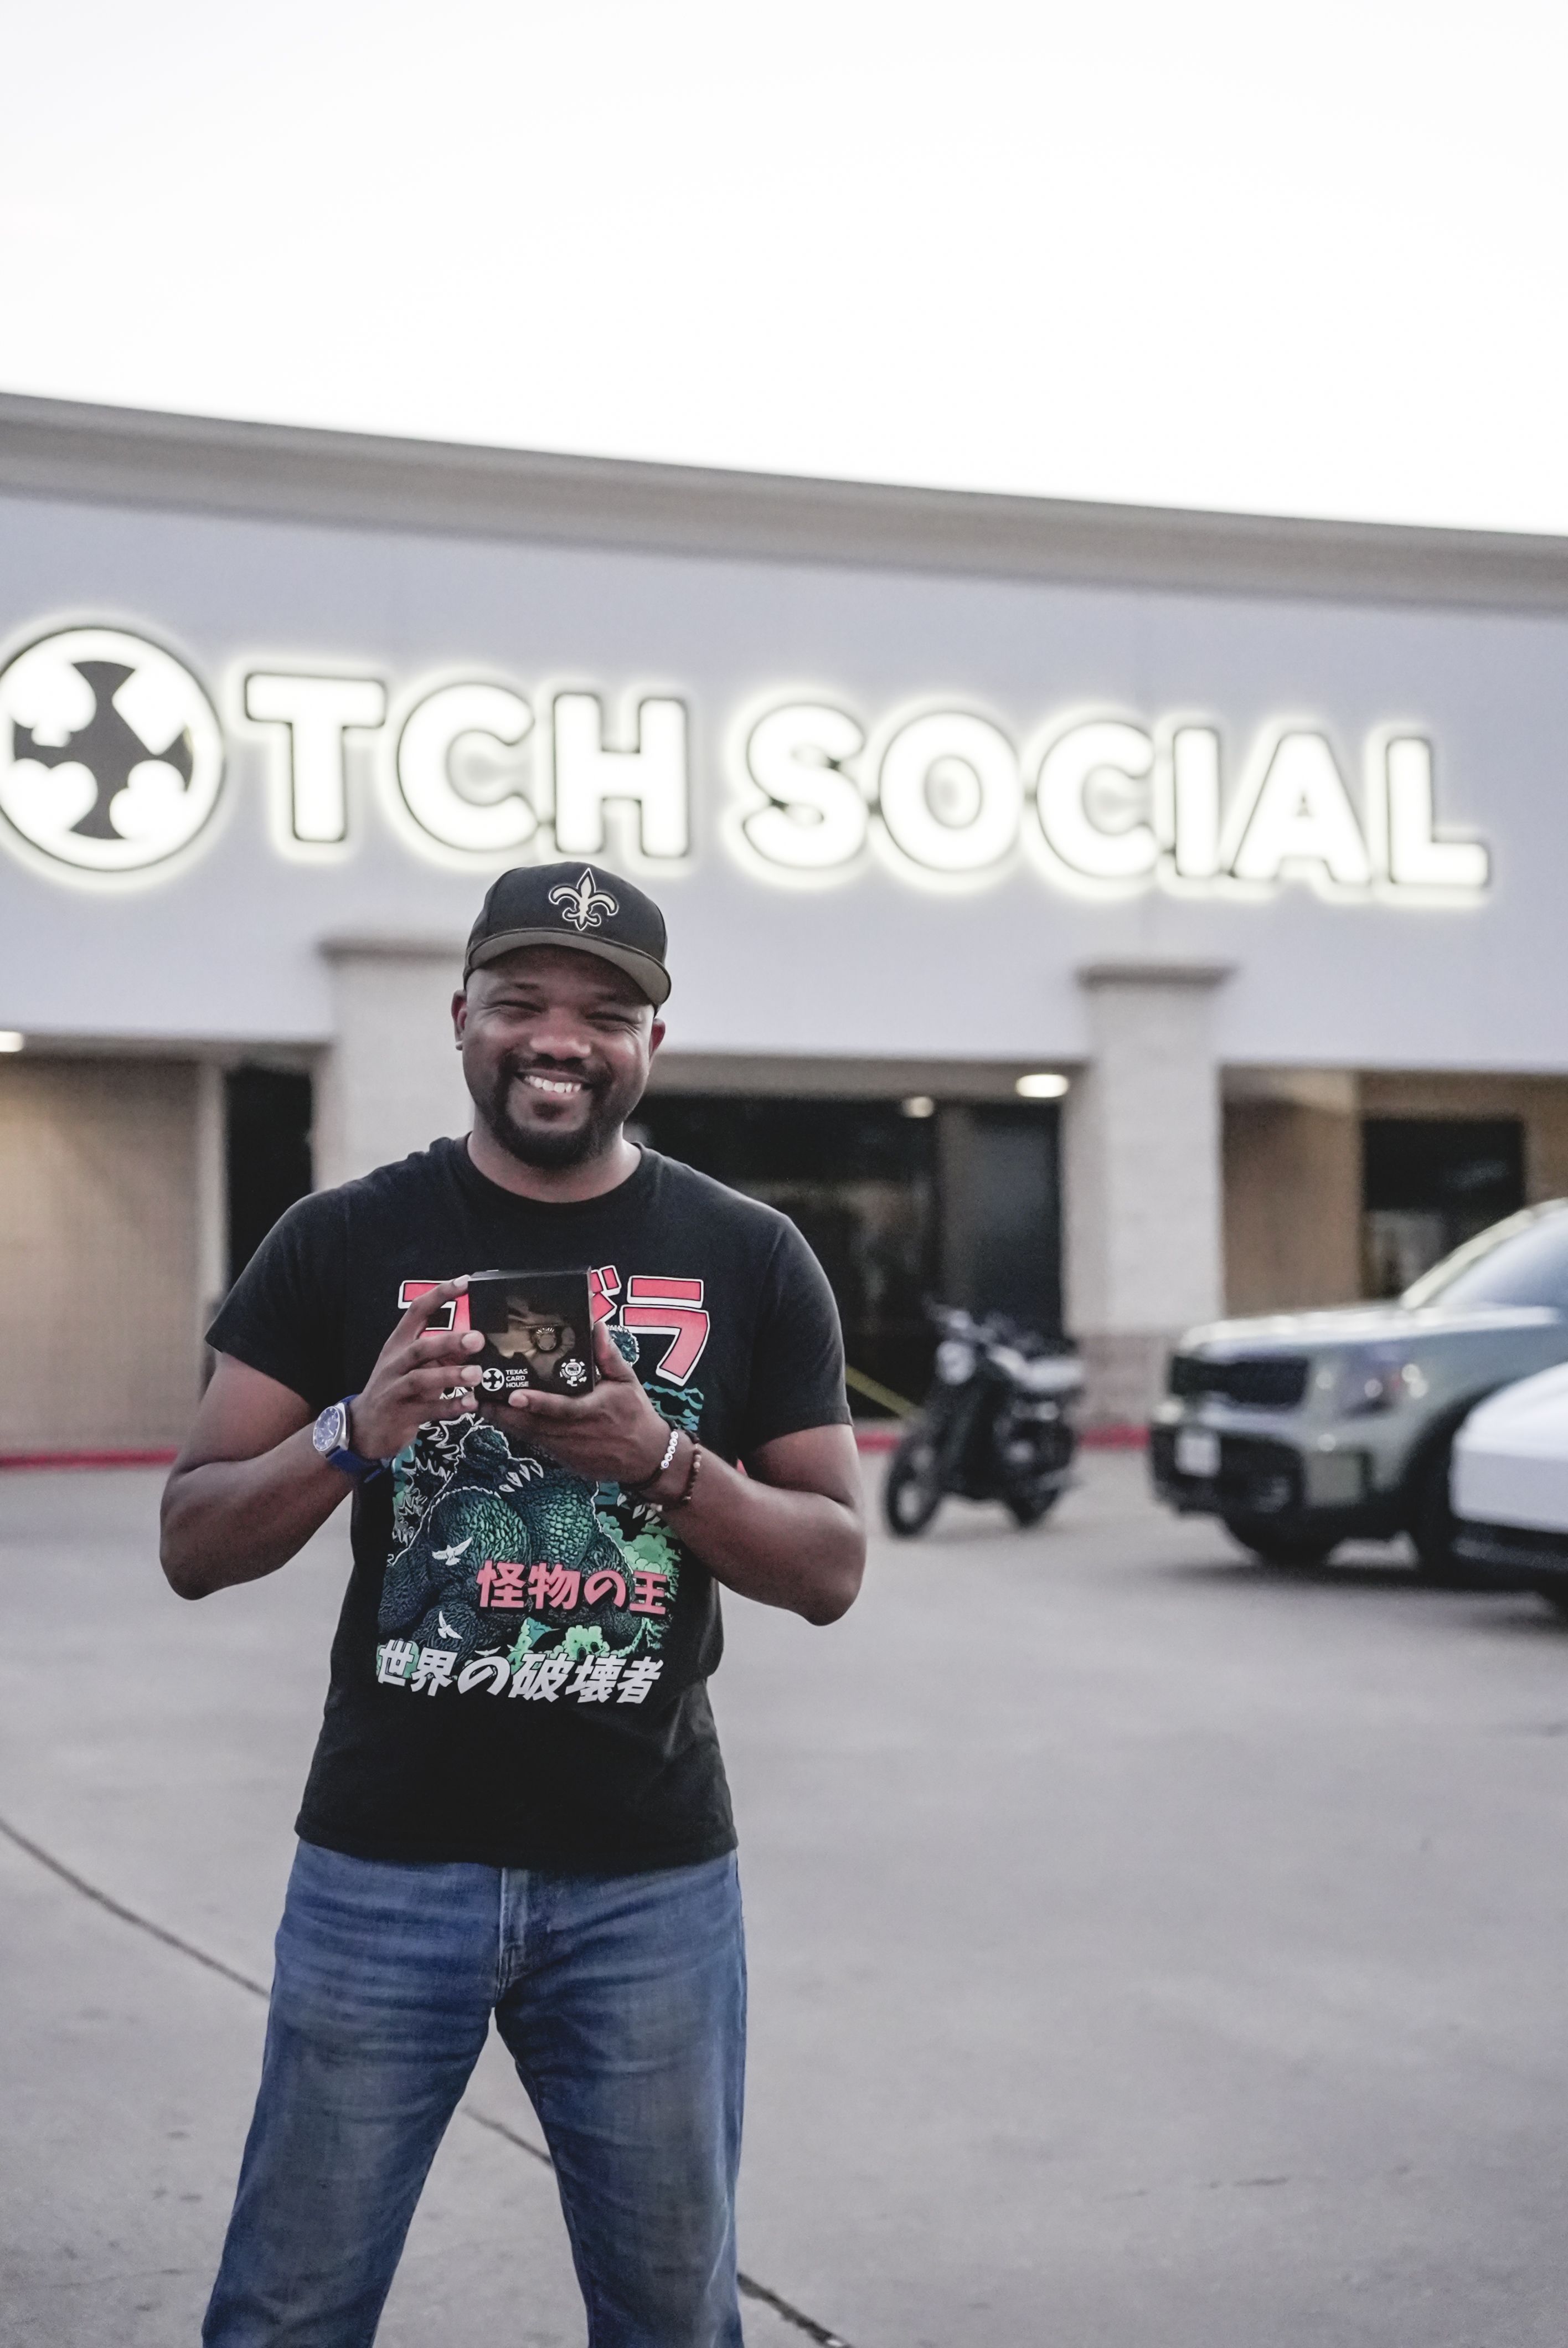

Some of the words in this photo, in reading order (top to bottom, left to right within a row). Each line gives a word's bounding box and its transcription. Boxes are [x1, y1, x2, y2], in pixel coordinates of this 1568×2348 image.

[244, 671, 690, 858] TCH
[742, 701, 1492, 885] SOCIAL
[476, 1559, 668, 1615] 怪物の王
[377, 1638, 663, 1705] 世界の破壊者
